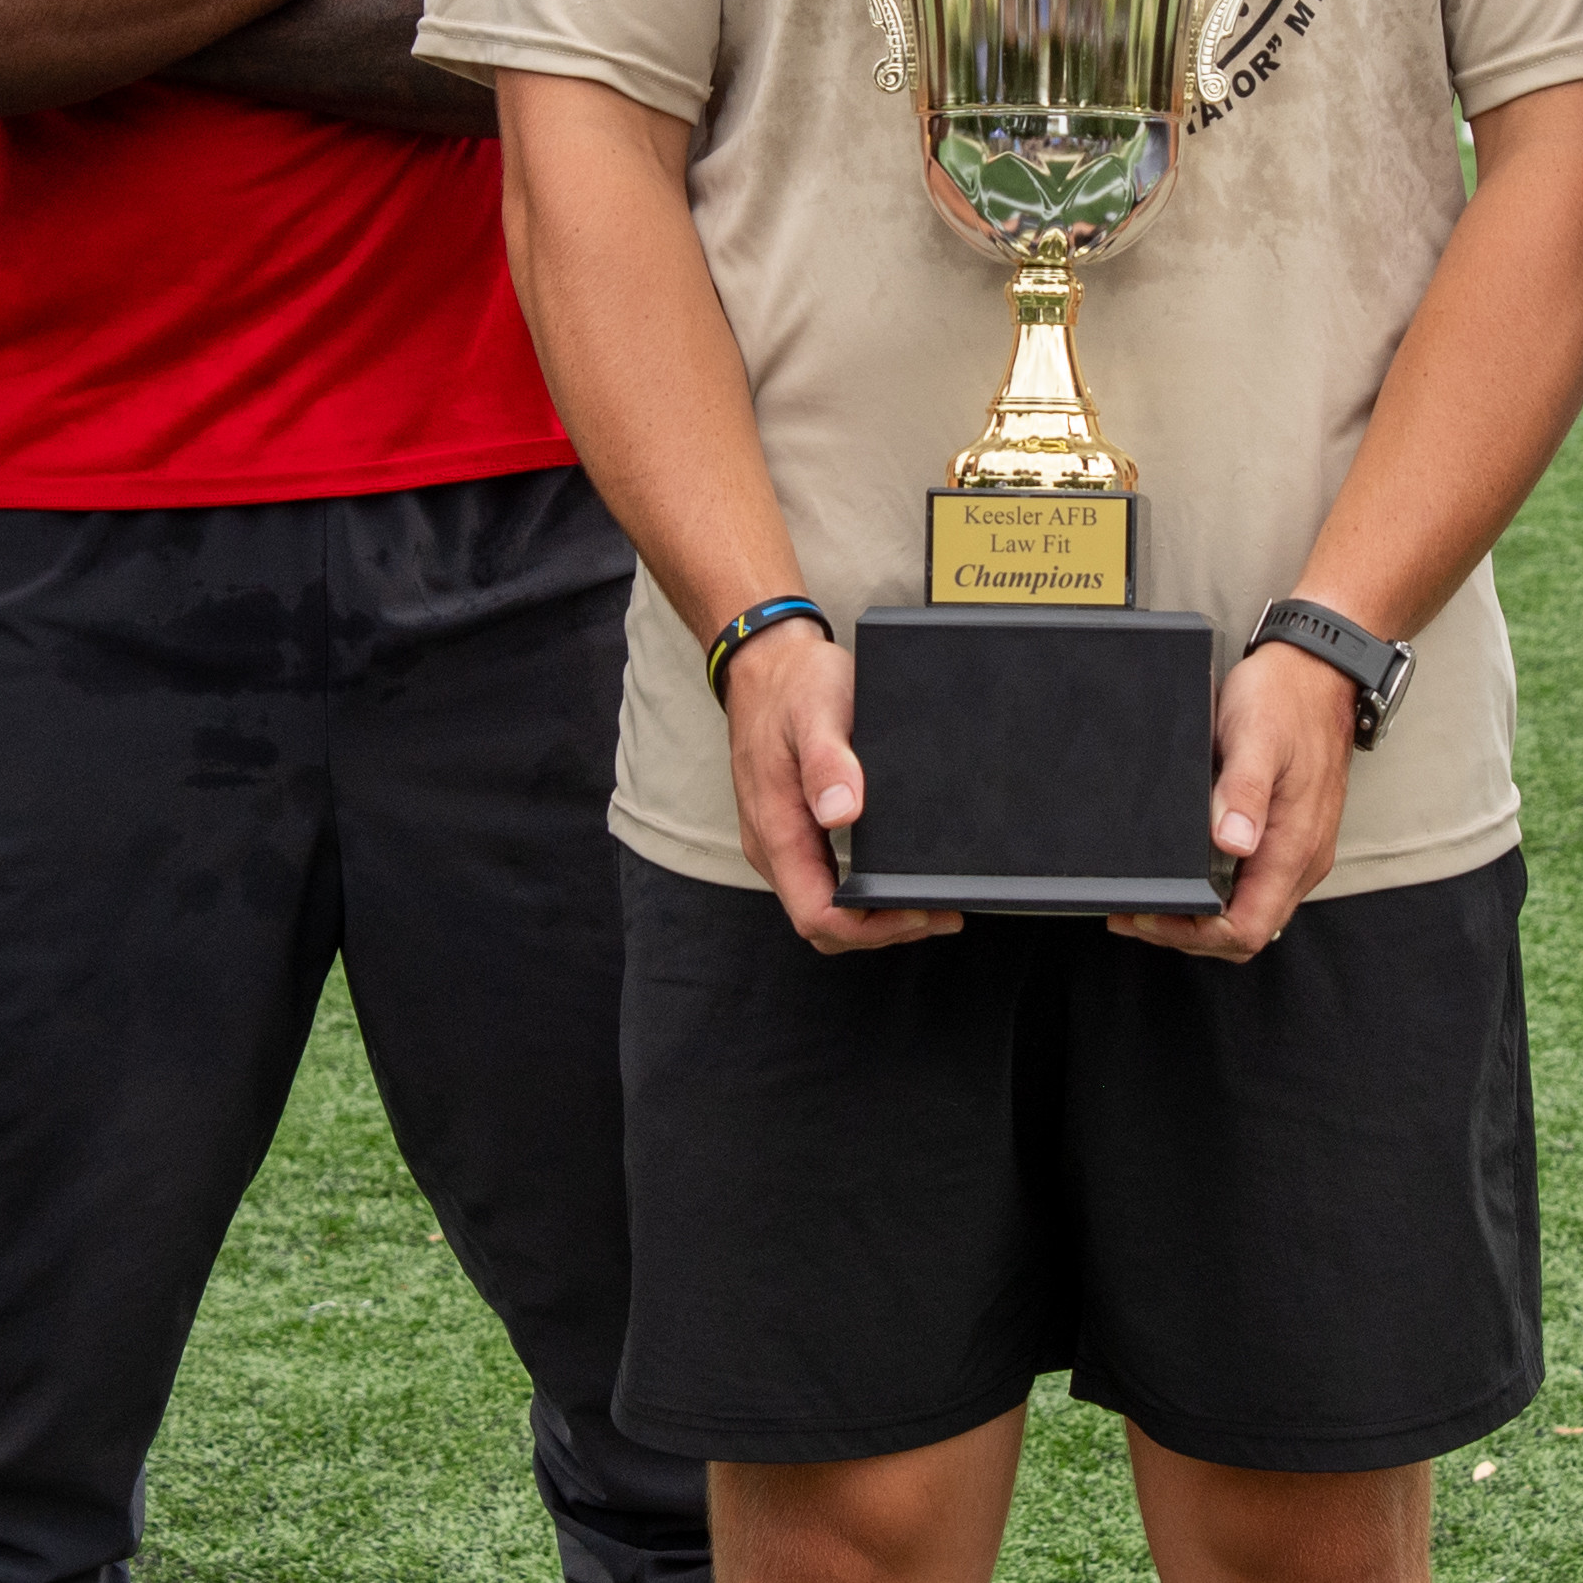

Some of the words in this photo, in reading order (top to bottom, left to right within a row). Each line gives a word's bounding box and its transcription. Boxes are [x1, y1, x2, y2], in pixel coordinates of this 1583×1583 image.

[964, 504, 1043, 526] Keesler
[1048, 506, 1098, 526] AFB
[990, 533, 1036, 554] Law
[1043, 534, 1072, 554] Fit
[954, 563, 1104, 595] Champions
